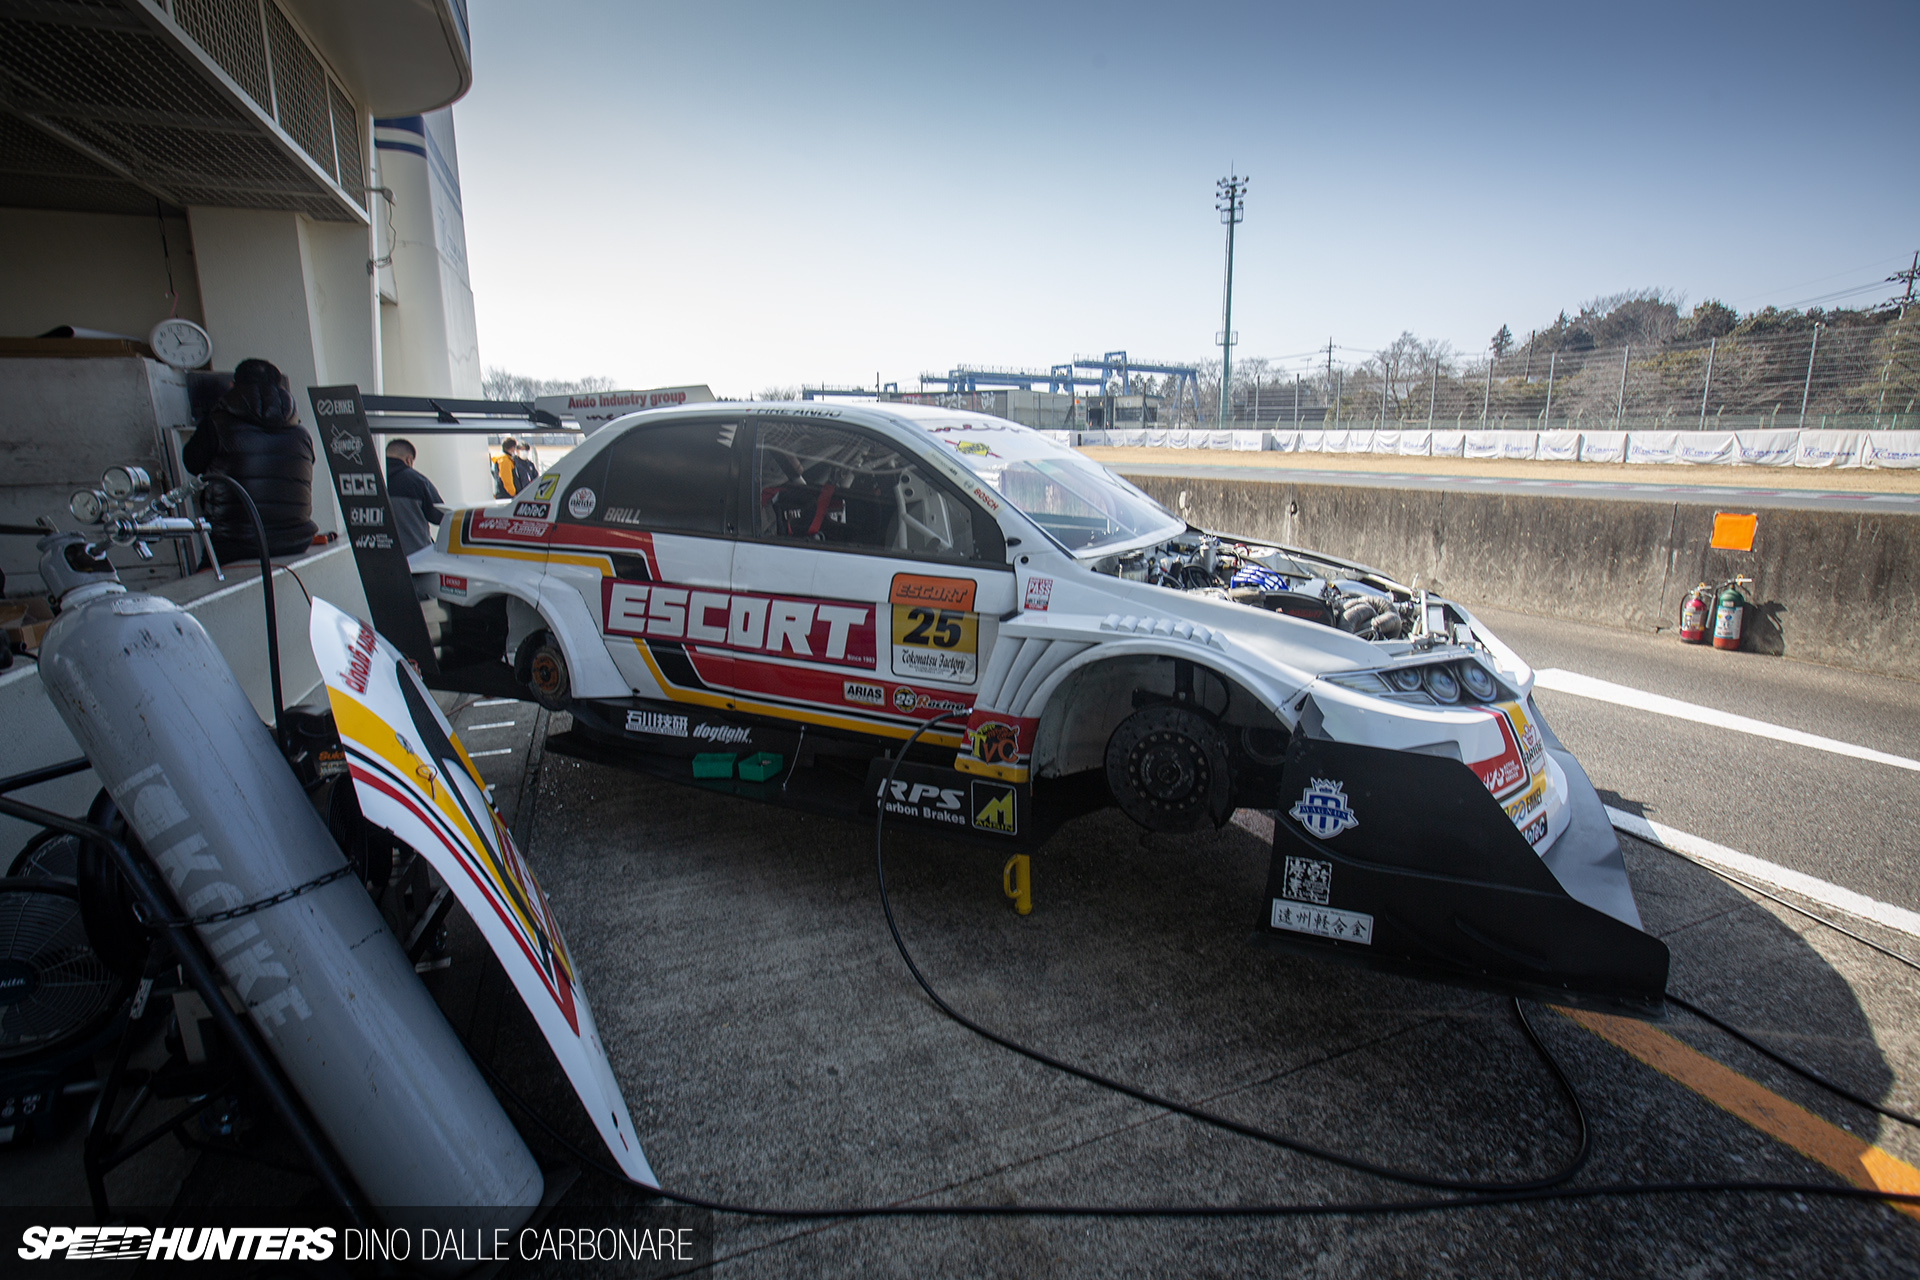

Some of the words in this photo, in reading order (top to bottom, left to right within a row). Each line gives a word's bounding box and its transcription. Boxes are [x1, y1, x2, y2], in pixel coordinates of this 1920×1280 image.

[334, 399, 355, 414] ENKEI
[568, 396, 597, 409] Ando
[599, 393, 647, 408] industry
[651, 390, 687, 406] group
[338, 473, 378, 496] GCG
[516, 502, 547, 517] MoTeC
[973, 488, 999, 511] BOSCH
[603, 507, 641, 525] BRILL
[895, 584, 969, 604] ESCORT
[1028, 582, 1051, 595] PASS
[608, 583, 869, 659] ESCORT
[903, 607, 966, 648] 25
[902, 648, 938, 667] Tokonatsu
[938, 653, 967, 676] Factory
[846, 684, 882, 699] ARIAS
[895, 692, 915, 705] 25
[916, 694, 966, 712] Racing
[626, 709, 689, 730] 石川技研
[876, 778, 965, 810] RPS
[1526, 788, 1543, 815] ENKEI
[922, 808, 966, 826] Brakes
[152, 832, 314, 1038] KOIKE
[0, 976, 26, 989] kita
